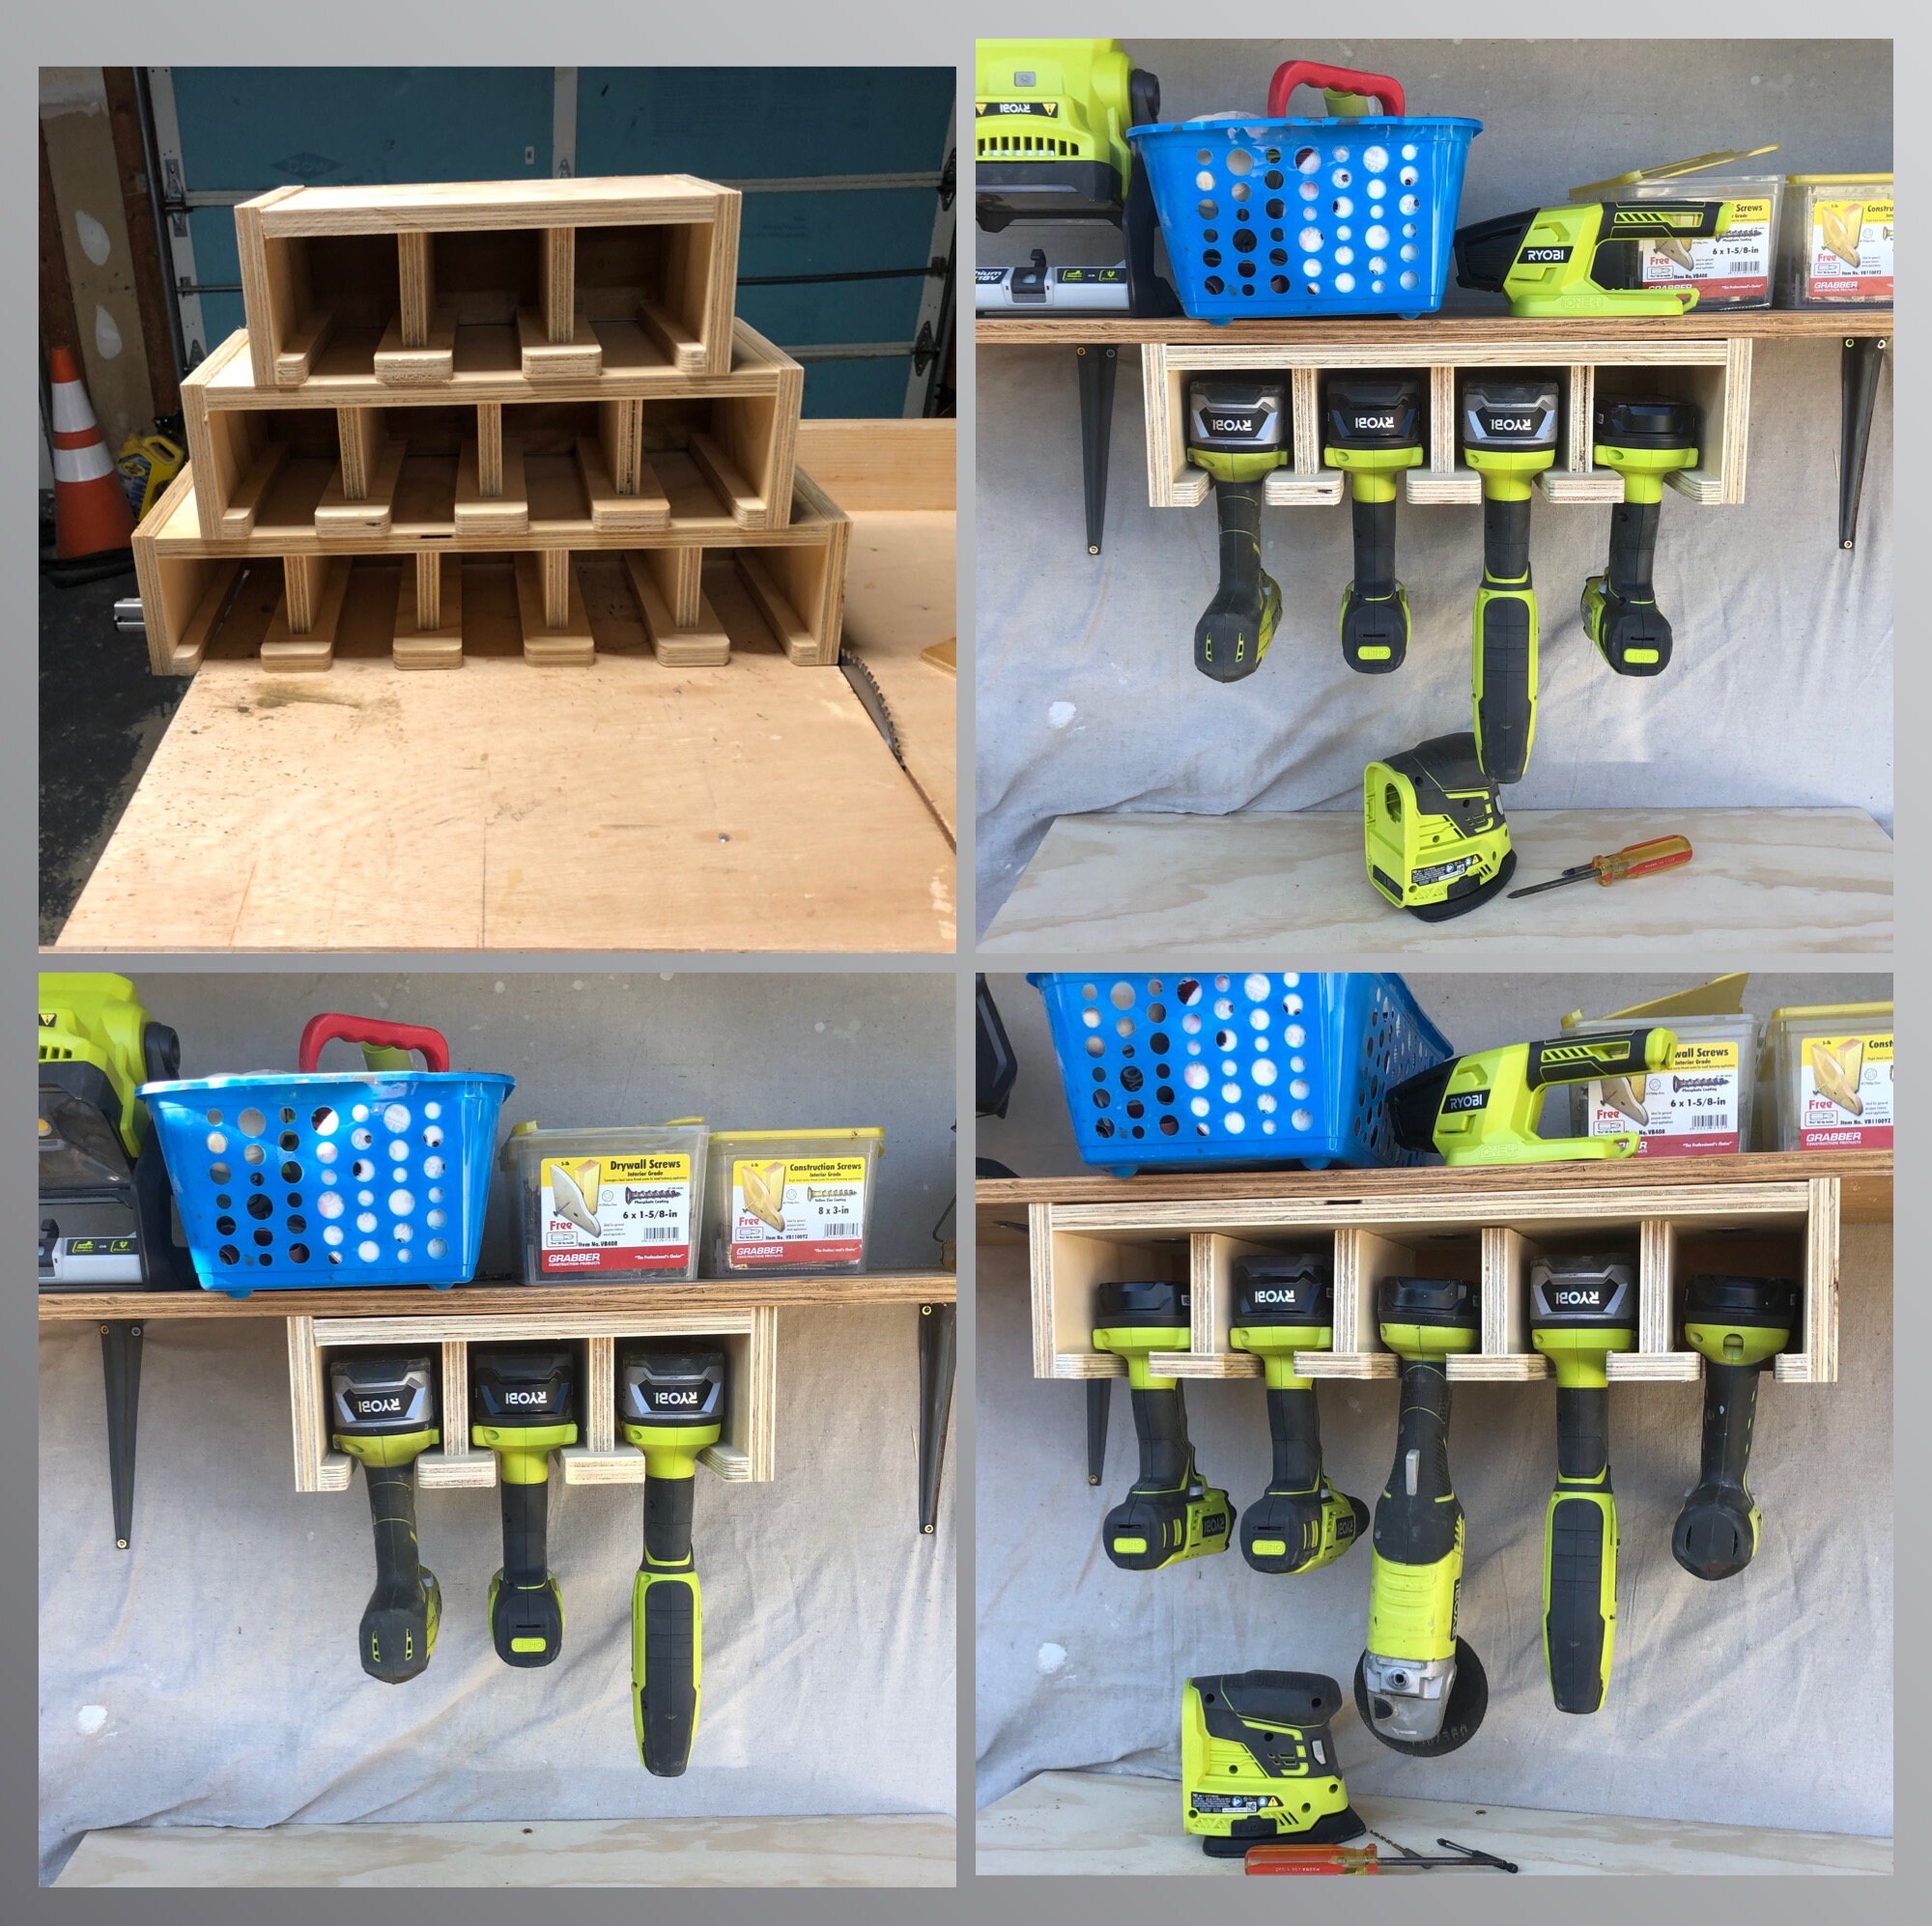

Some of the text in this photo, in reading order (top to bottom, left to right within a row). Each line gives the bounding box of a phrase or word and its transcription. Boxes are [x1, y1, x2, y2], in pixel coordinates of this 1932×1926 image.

[1000, 103, 1031, 113] RYOBI
[1736, 204, 1763, 212] Screws
[1527, 249, 1564, 261] RYOBI
[1726, 246, 1759, 255] 1-5/8-in
[1650, 257, 1670, 266] Free
[1817, 253, 1837, 262] Free
[1212, 419, 1252, 431] RYOBI
[1355, 416, 1394, 428] RYOBI
[1491, 418, 1532, 431] RYOBI
[1697, 1047, 1728, 1057] Screws
[1450, 1093, 1482, 1110] RYOBI
[1688, 1098, 1725, 1108] 1-5/8-in
[1808, 1100, 1833, 1110] Free
[1597, 1110, 1619, 1119] Free
[1805, 1132, 1861, 1142] GRABBER
[611, 1159, 681, 1172] Drywall Screws
[790, 1163, 835, 1172] Construction
[639, 1210, 677, 1219] 1-5/8-in
[833, 1205, 849, 1214] 3-in
[550, 1221, 573, 1231] Free
[739, 1217, 759, 1226] Free
[736, 1246, 783, 1255] GRABBER
[548, 1253, 600, 1262] GRABBER
[1255, 1289, 1295, 1303] RYOBI
[1555, 1290, 1600, 1305] RYOBI
[505, 1391, 548, 1404] RYOBI
[655, 1391, 697, 1404] RYOBI
[358, 1398, 401, 1413] RYOBI
